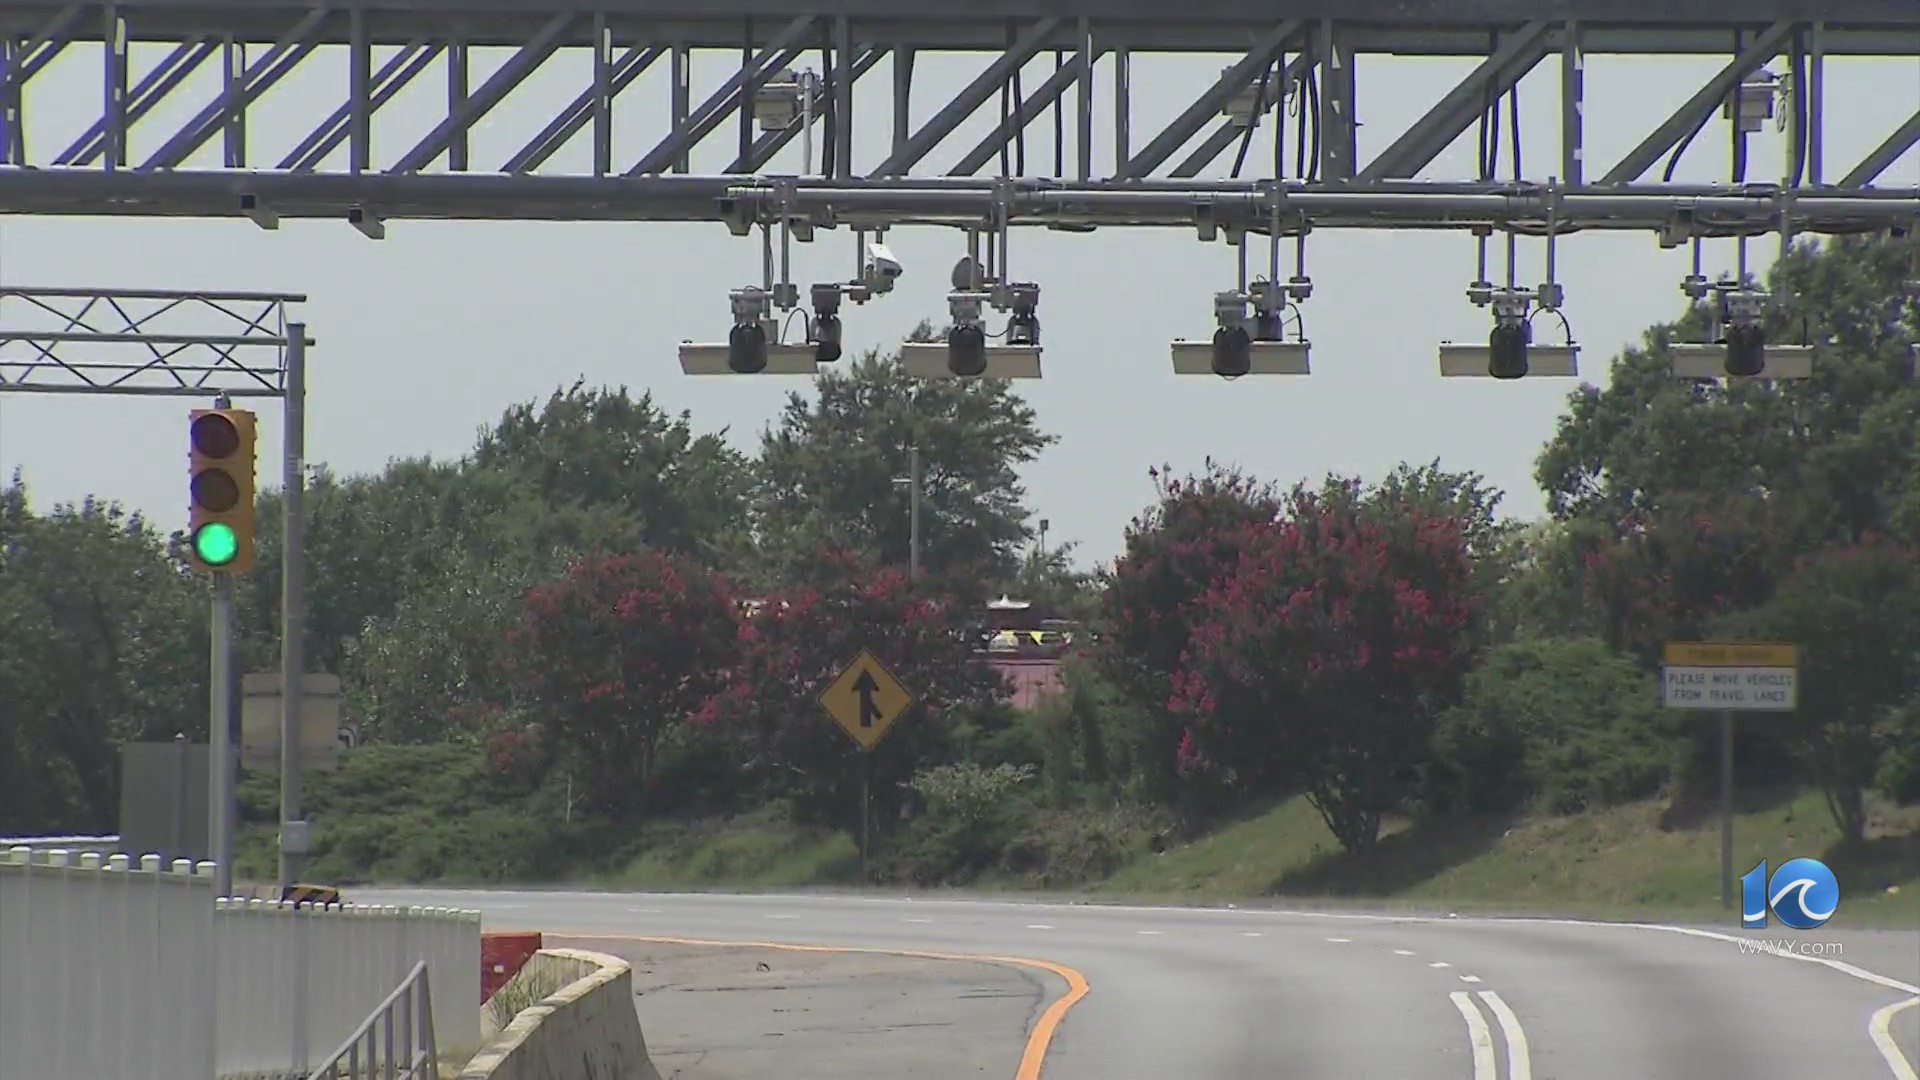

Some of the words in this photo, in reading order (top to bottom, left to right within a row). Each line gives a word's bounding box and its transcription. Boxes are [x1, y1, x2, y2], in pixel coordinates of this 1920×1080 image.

[1668, 673, 1705, 685] PLEASE
[1712, 674, 1739, 685] MOVE
[1747, 675, 1792, 686] VEHICLES
[1674, 689, 1702, 699] FROM
[1709, 690, 1745, 700] TRAVEL
[1754, 690, 1785, 701] LANES
